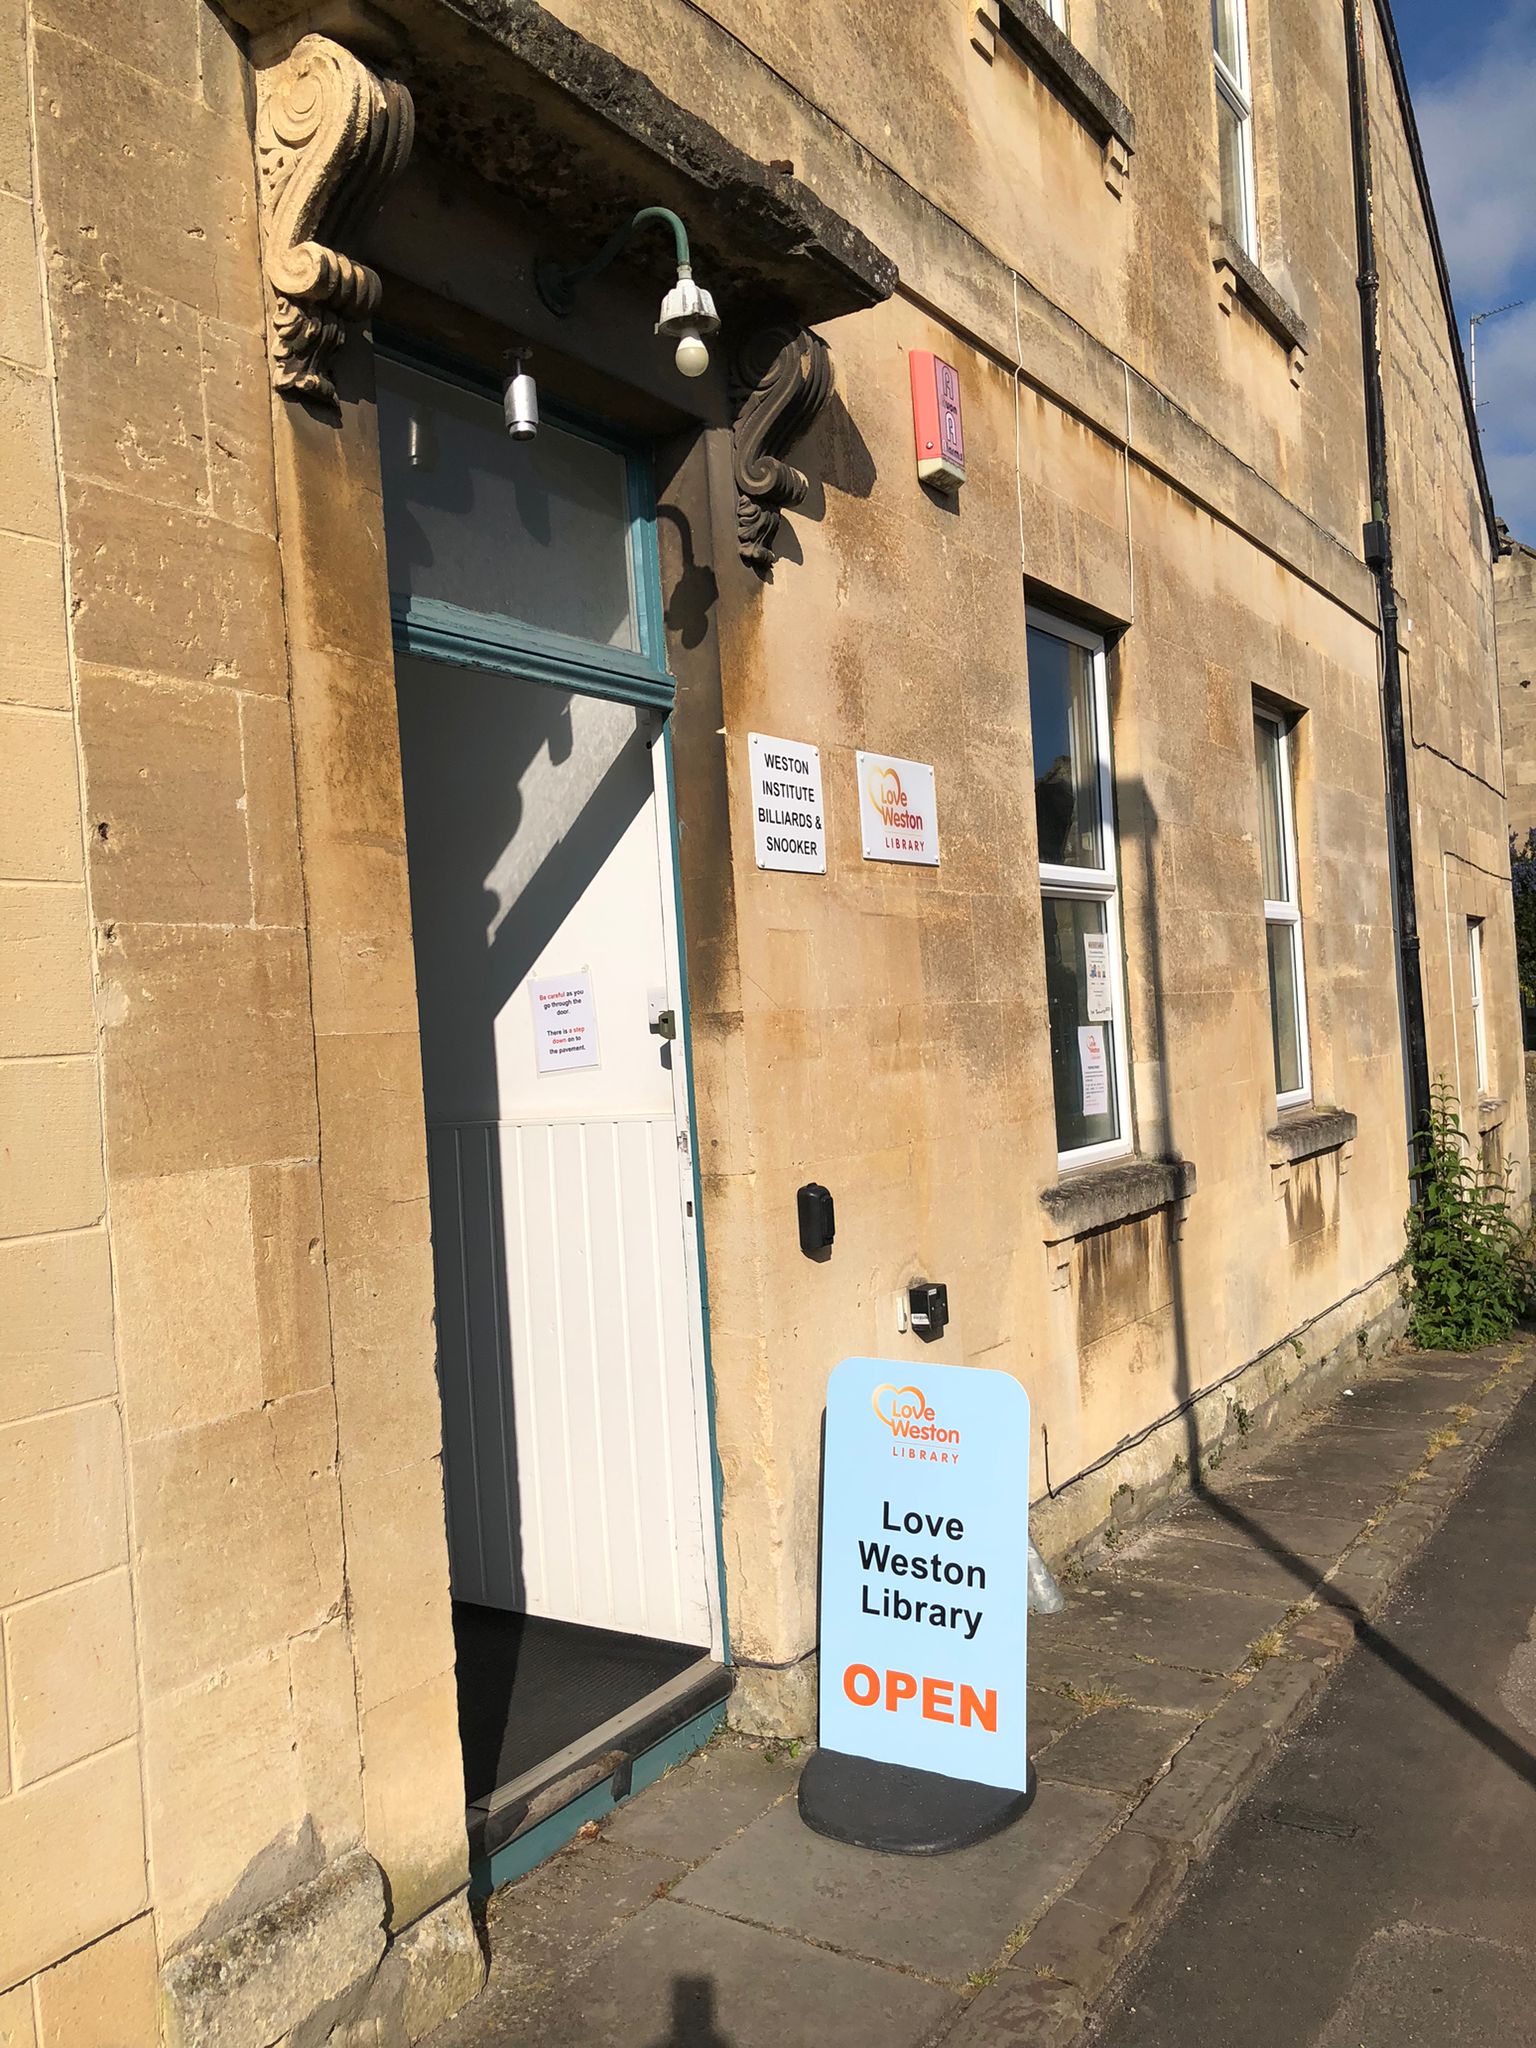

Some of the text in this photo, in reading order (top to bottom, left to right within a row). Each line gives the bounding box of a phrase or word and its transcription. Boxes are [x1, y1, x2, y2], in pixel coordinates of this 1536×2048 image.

[764, 753, 809, 776] WESTON
[762, 780, 815, 803] INSTITUTE
[880, 784, 908, 807] Love
[758, 807, 822, 830] BILLIARDS &
[881, 806, 923, 831] Weston
[766, 836, 818, 856] SNOOKER
[885, 837, 925, 852] LIBRARY
[551, 1000, 572, 1008] through
[574, 989, 584, 997] you
[547, 1029, 562, 1037] There
[892, 1399, 936, 1422] Love
[891, 1418, 960, 1445] Weston
[892, 1446, 959, 1465] LIBRARY
[882, 1500, 965, 1541] Love
[857, 1540, 987, 1590] Weston
[861, 1584, 983, 1640] Library
[842, 1662, 998, 1734] OPEN
